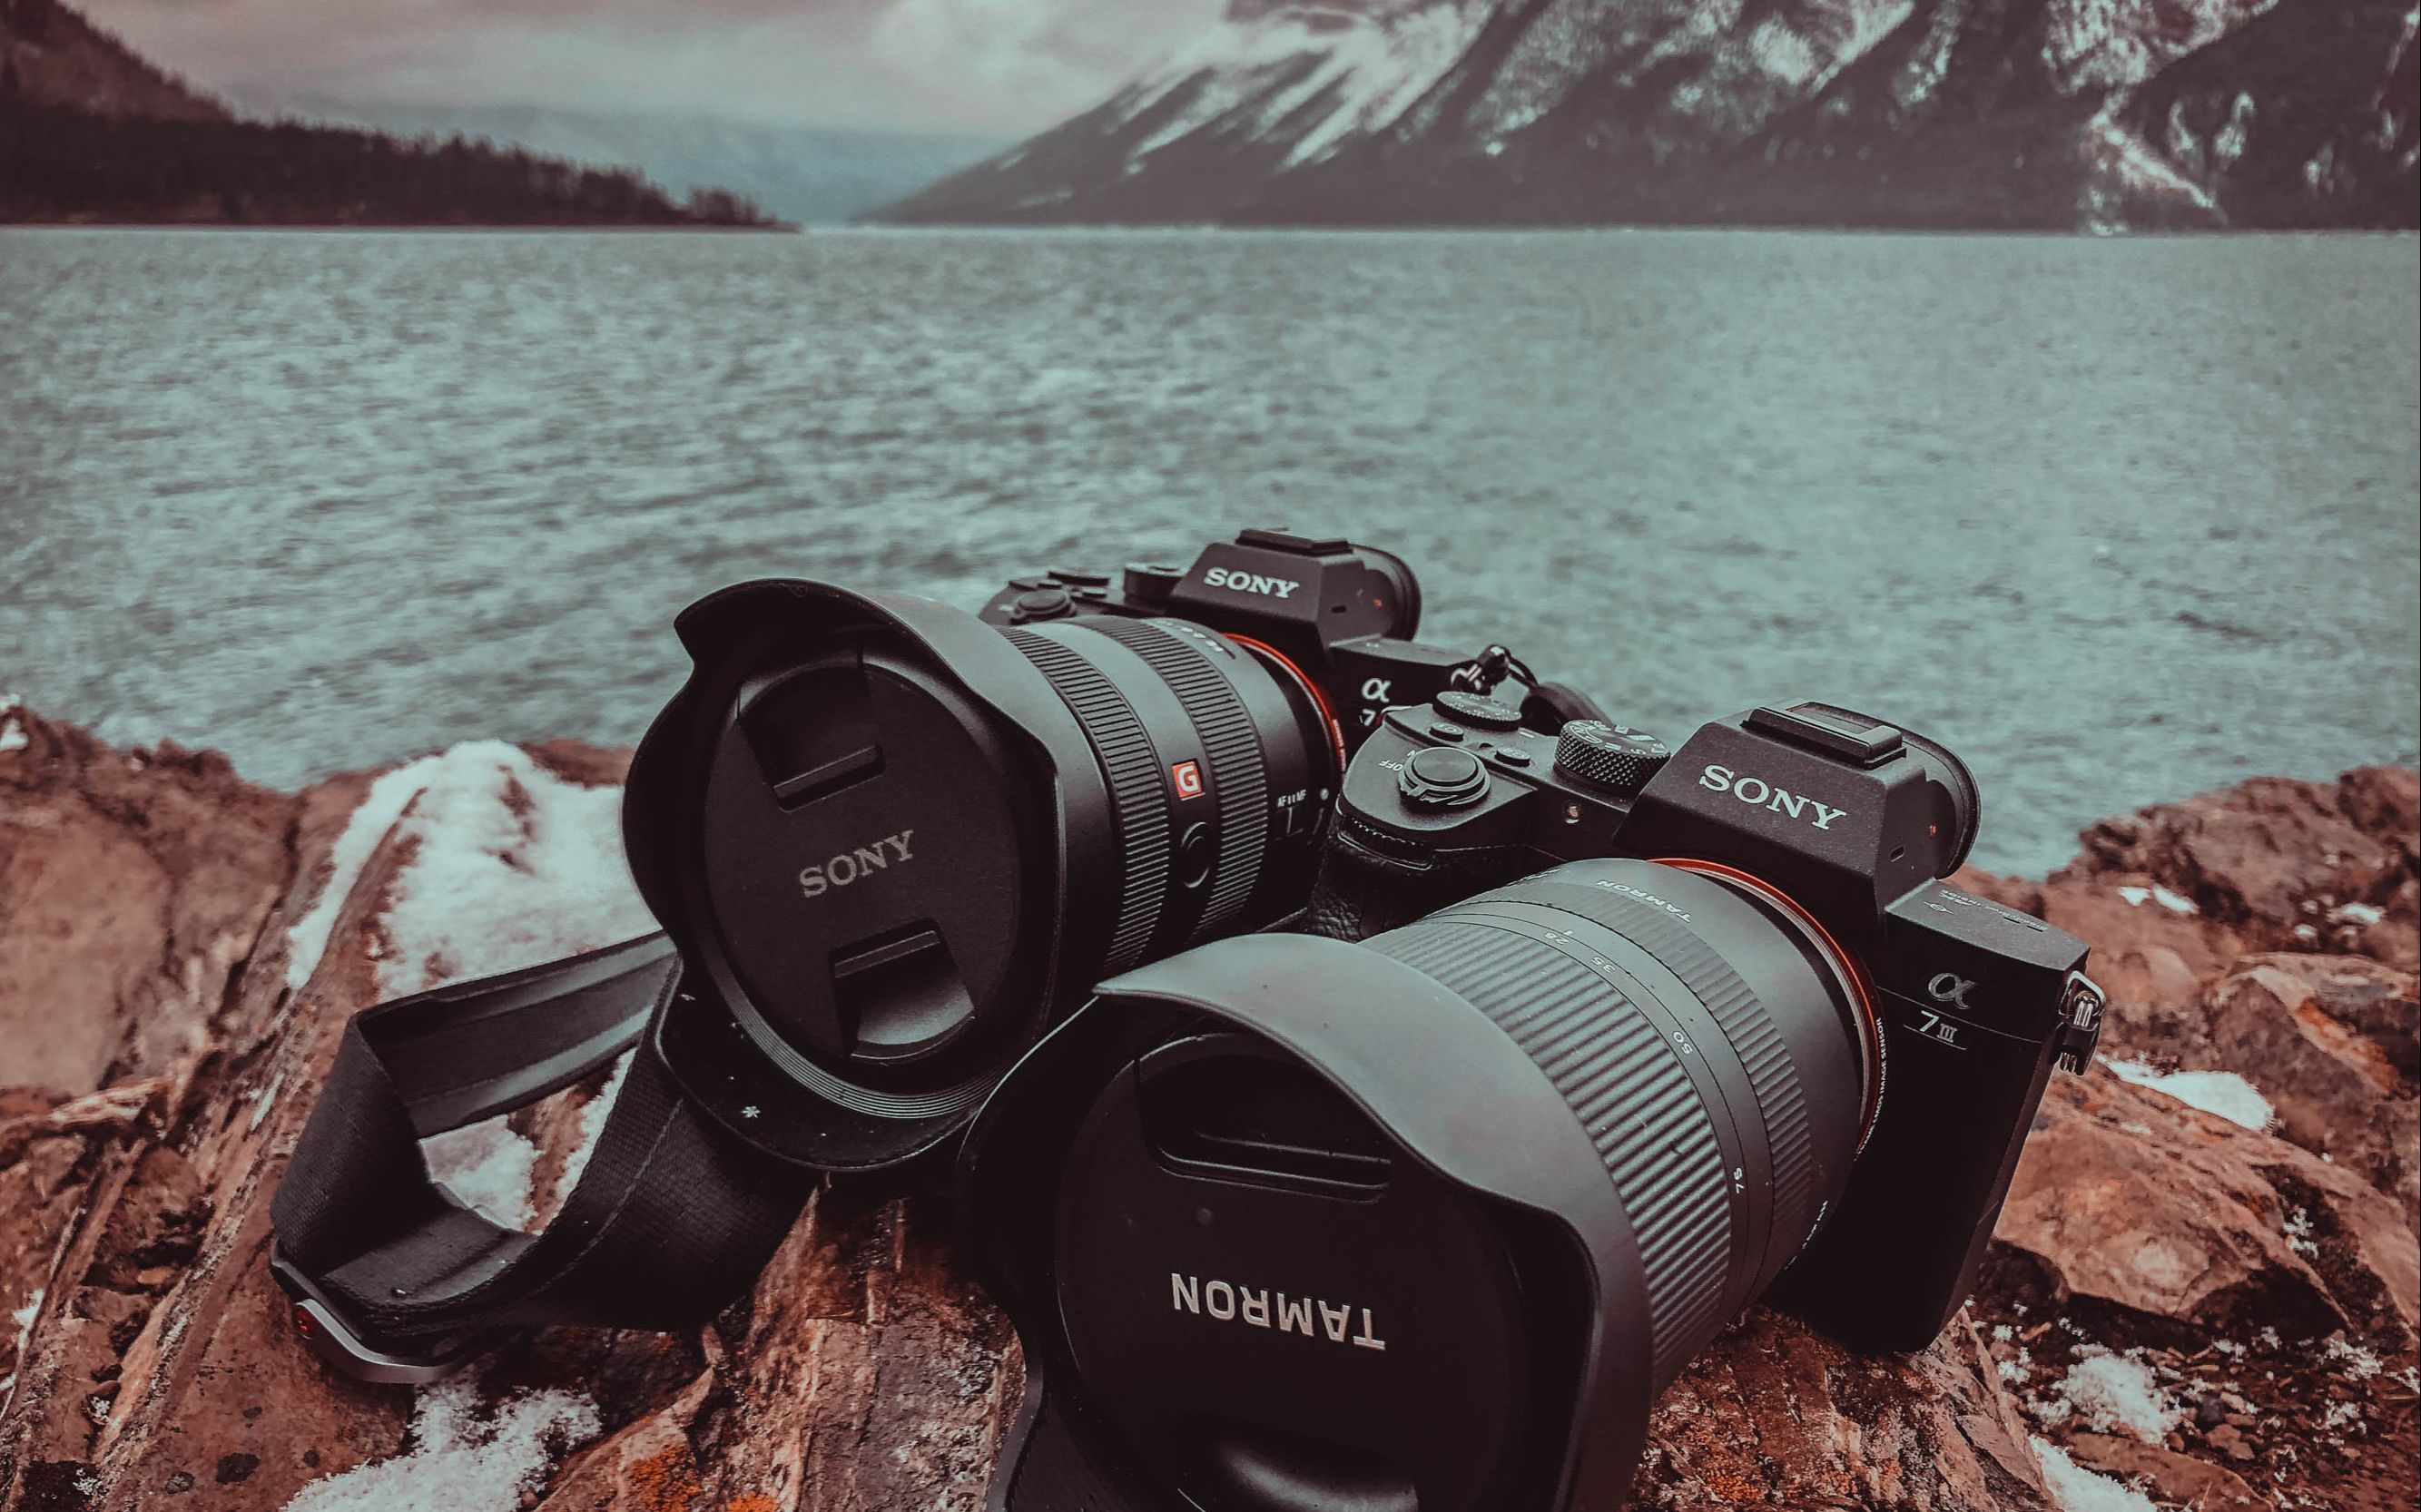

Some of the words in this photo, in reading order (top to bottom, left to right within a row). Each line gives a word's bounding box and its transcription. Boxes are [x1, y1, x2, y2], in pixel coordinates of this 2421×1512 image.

[1204, 567, 1300, 598] SONY
[1178, 765, 1199, 792] G
[1379, 760, 1403, 771] OFF
[1698, 764, 1847, 830] SONY
[799, 830, 914, 898] SONY
[1597, 879, 1692, 924] TAMRON
[1544, 932, 1570, 946] 28
[1590, 956, 1617, 974] 35
[1672, 1031, 1694, 1055] 50
[1733, 1167, 1745, 1194] 75
[1171, 1272, 1386, 1351] TAMRON
